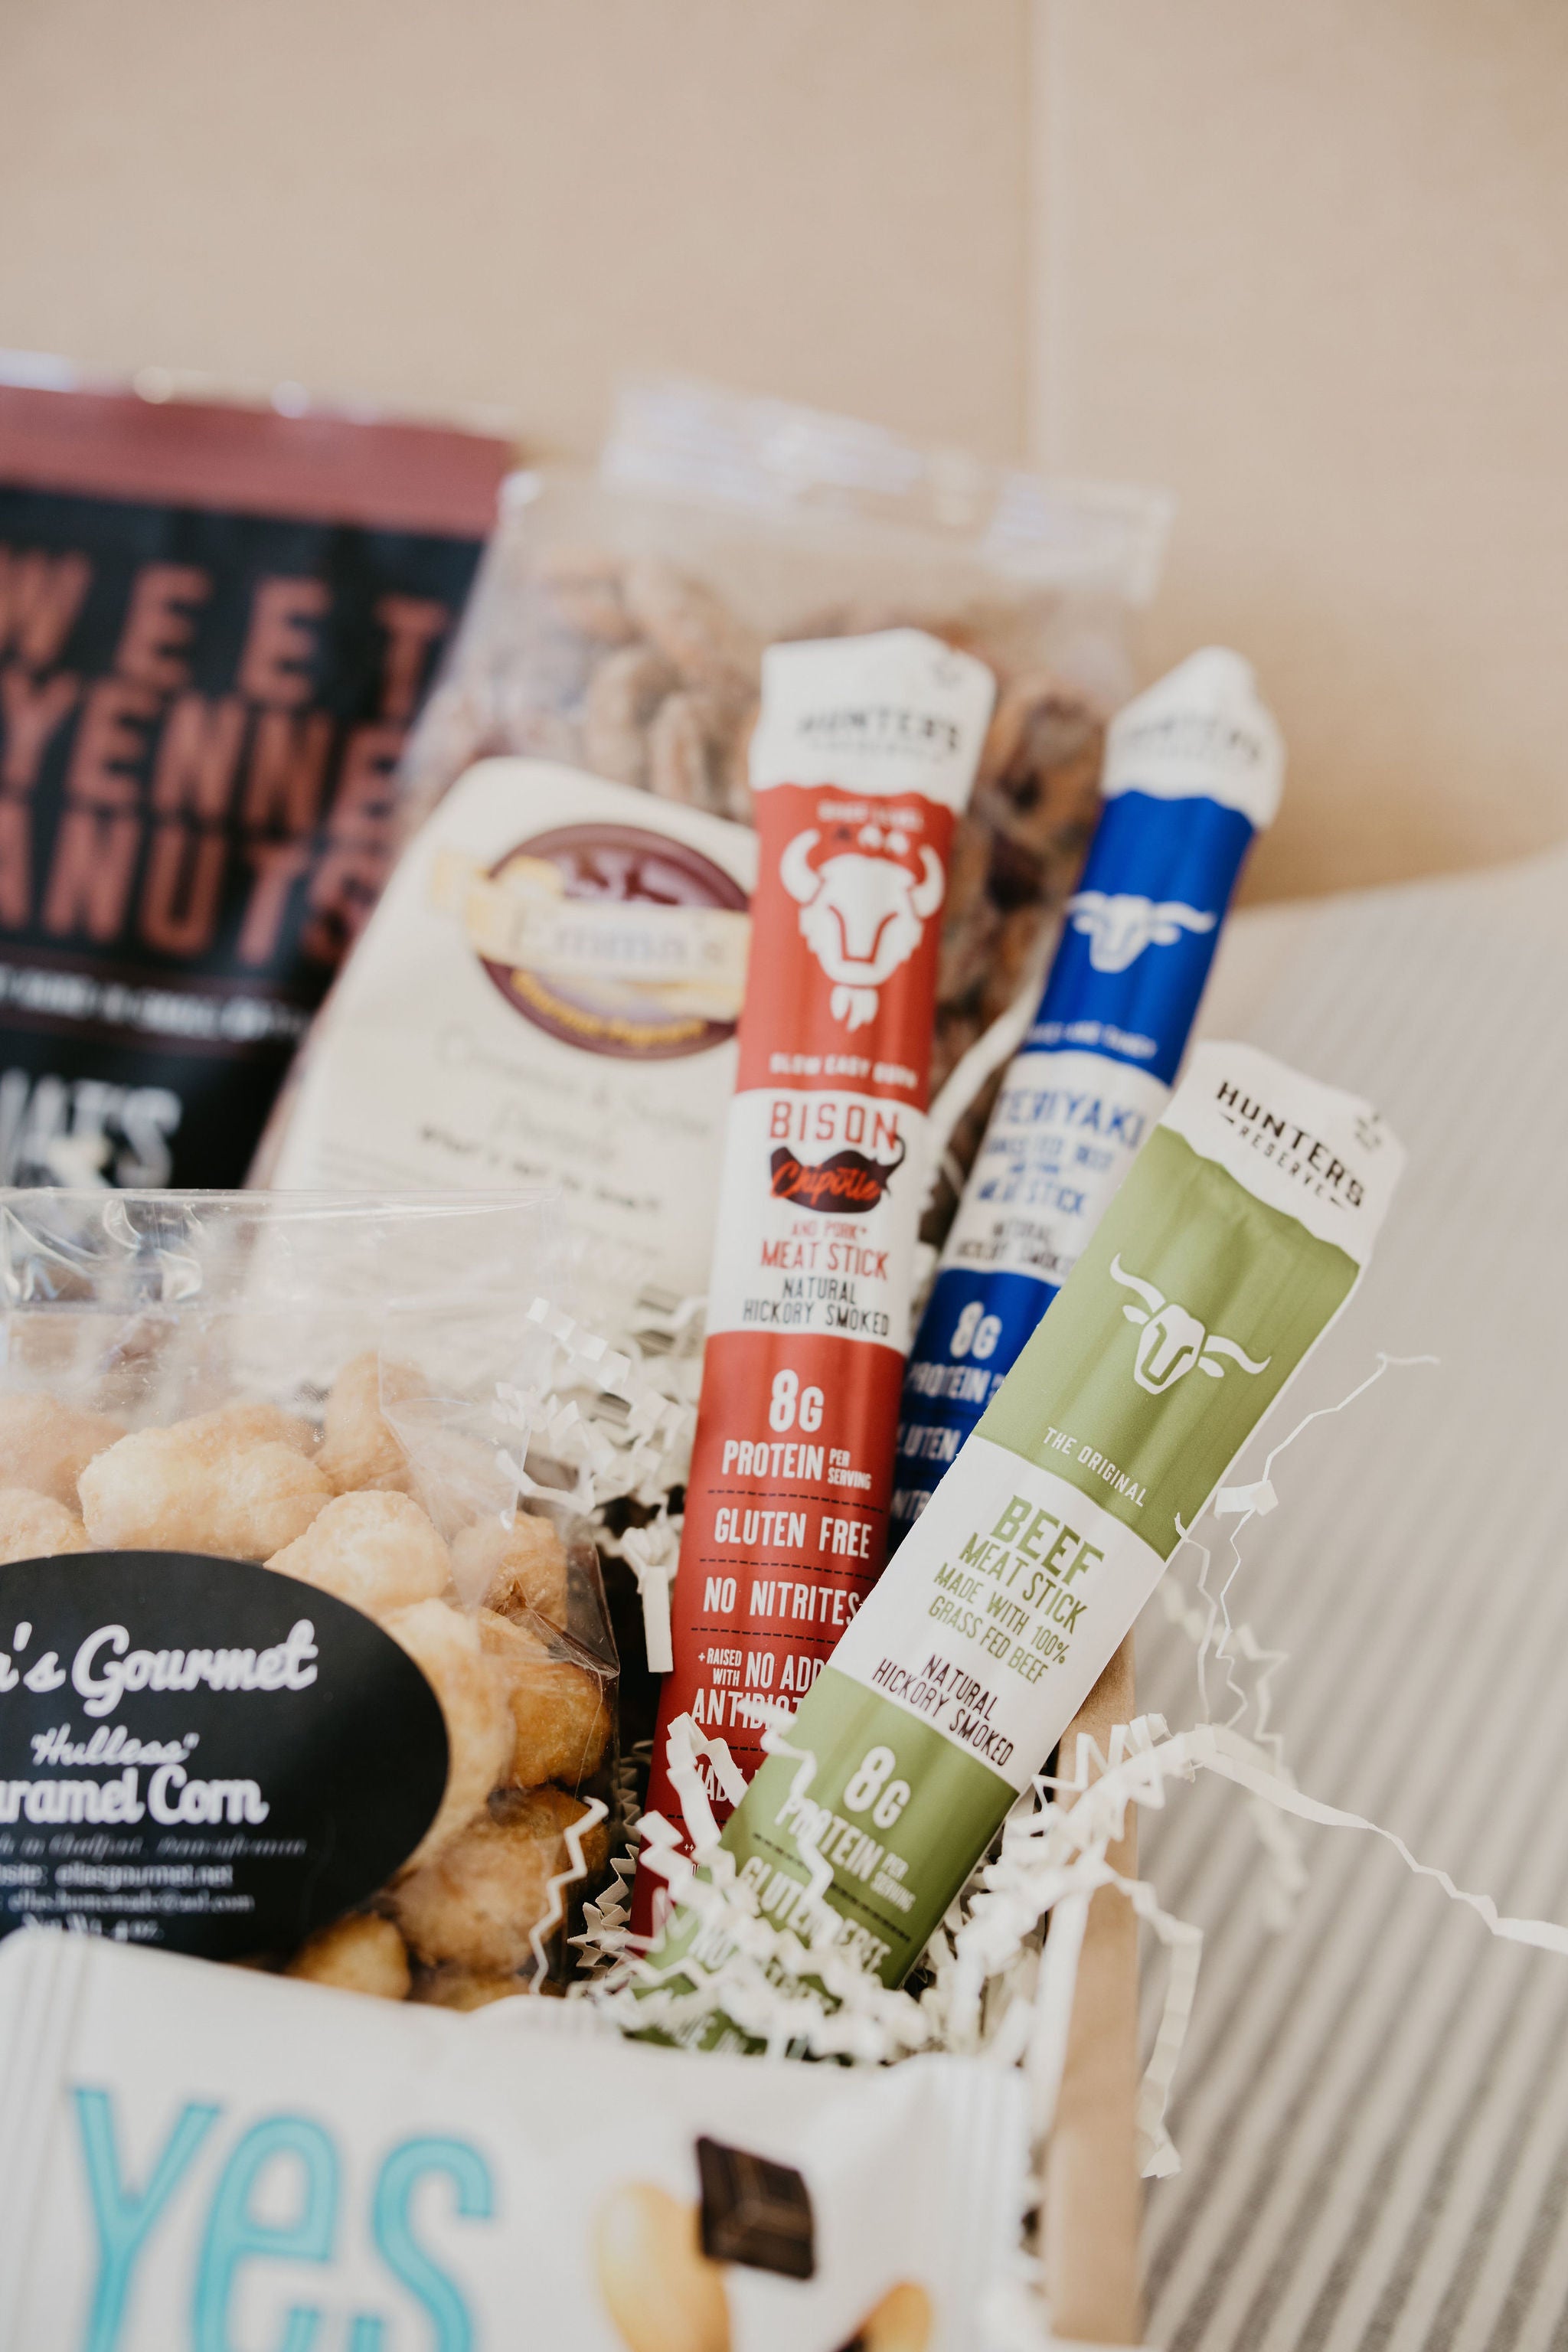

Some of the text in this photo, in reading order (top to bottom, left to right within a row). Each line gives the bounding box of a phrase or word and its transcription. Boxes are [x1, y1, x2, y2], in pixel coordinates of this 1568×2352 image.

[769, 1101, 900, 1150] BISON
[1216, 1081, 1364, 1207] HUNTERS
[770, 1162, 883, 1207] Chipotle
[1239, 1124, 1326, 1199] RESERVE
[761, 1240, 889, 1281] MEAT STICK
[782, 1276, 857, 1305] NATURAL
[742, 1300, 890, 1337] HICKORY SMOKED
[950, 1301, 1002, 1361] 8G
[768, 1369, 825, 1432] 8G
[722, 1439, 851, 1483] PROTEIN PER
[827, 1468, 871, 1491] SERVING
[1043, 1427, 1144, 1508] THE ORIGINAL
[714, 1507, 873, 1560] GLUTEN FREE
[990, 1494, 1104, 1587] BEEF
[703, 1577, 737, 1613] NO
[934, 1563, 1070, 1665] MADE WITH 100%
[958, 1534, 1088, 1635] MEAT STICK
[72, 1619, 318, 1717] Gourmet
[712, 1668, 740, 1687] WITH
[745, 1651, 775, 1689] NO
[928, 1596, 1049, 1684] GRASS FED BEEF
[872, 1658, 1014, 1767] HICKORY SMOKED
[921, 1654, 998, 1721] NATURAL
[148, 1763, 270, 1825] Corn
[843, 1745, 911, 1829] 8G
[774, 1798, 884, 1883] PROTEIN
